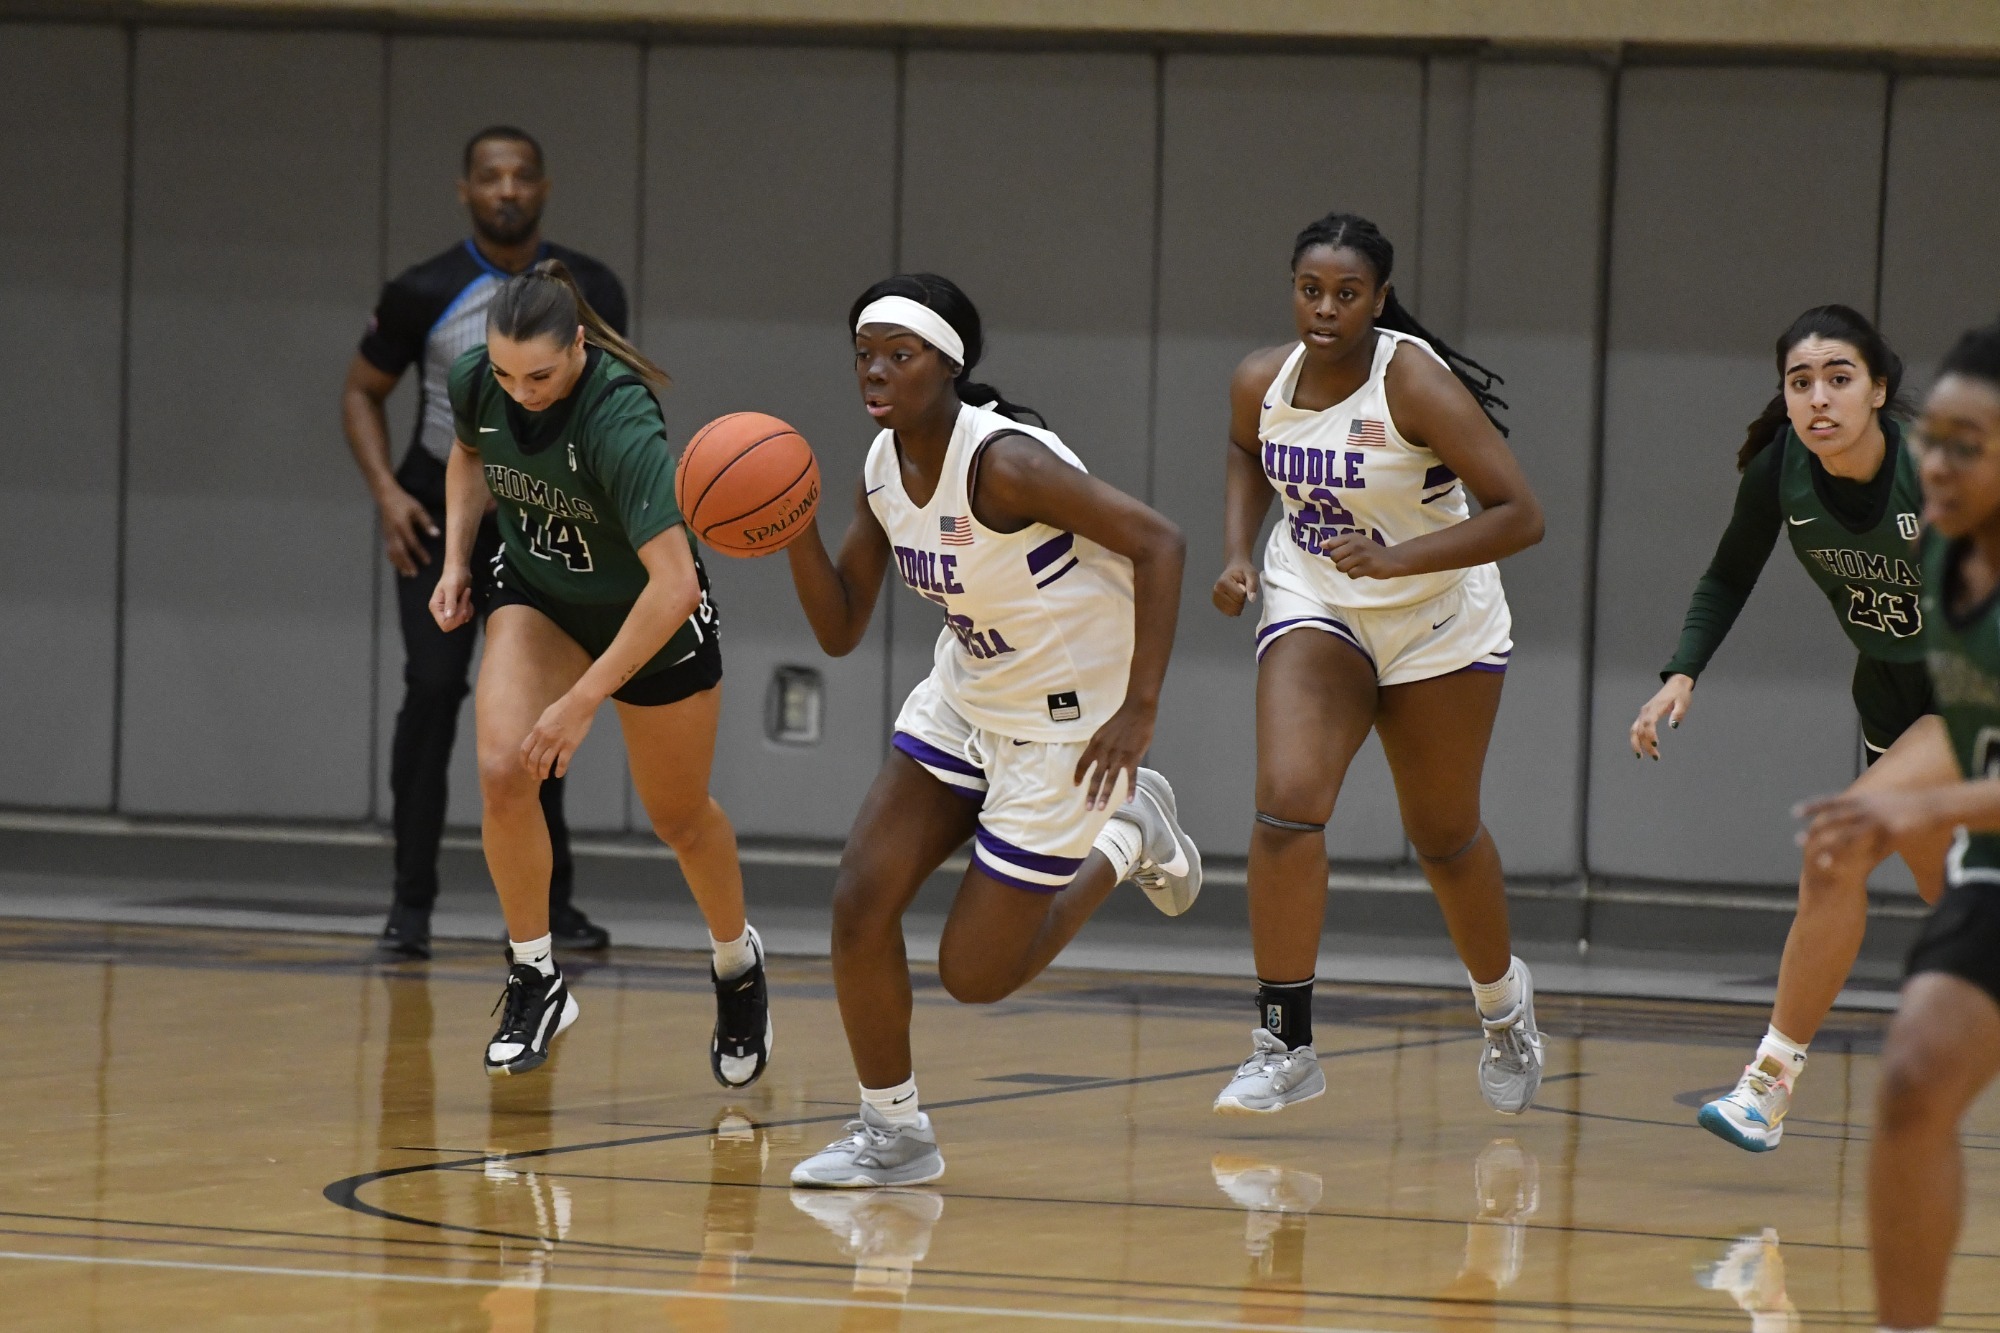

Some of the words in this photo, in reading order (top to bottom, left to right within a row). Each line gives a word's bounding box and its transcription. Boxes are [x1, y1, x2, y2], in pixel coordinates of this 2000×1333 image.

[1265, 440, 1366, 488] MIDDLE
[743, 480, 818, 545] SPALDING
[520, 507, 594, 571] 14
[894, 545, 965, 594] IDDLE
[1807, 548, 1922, 586] THOMA
[1848, 583, 1922, 638] 23
[1058, 696, 1068, 706] L
